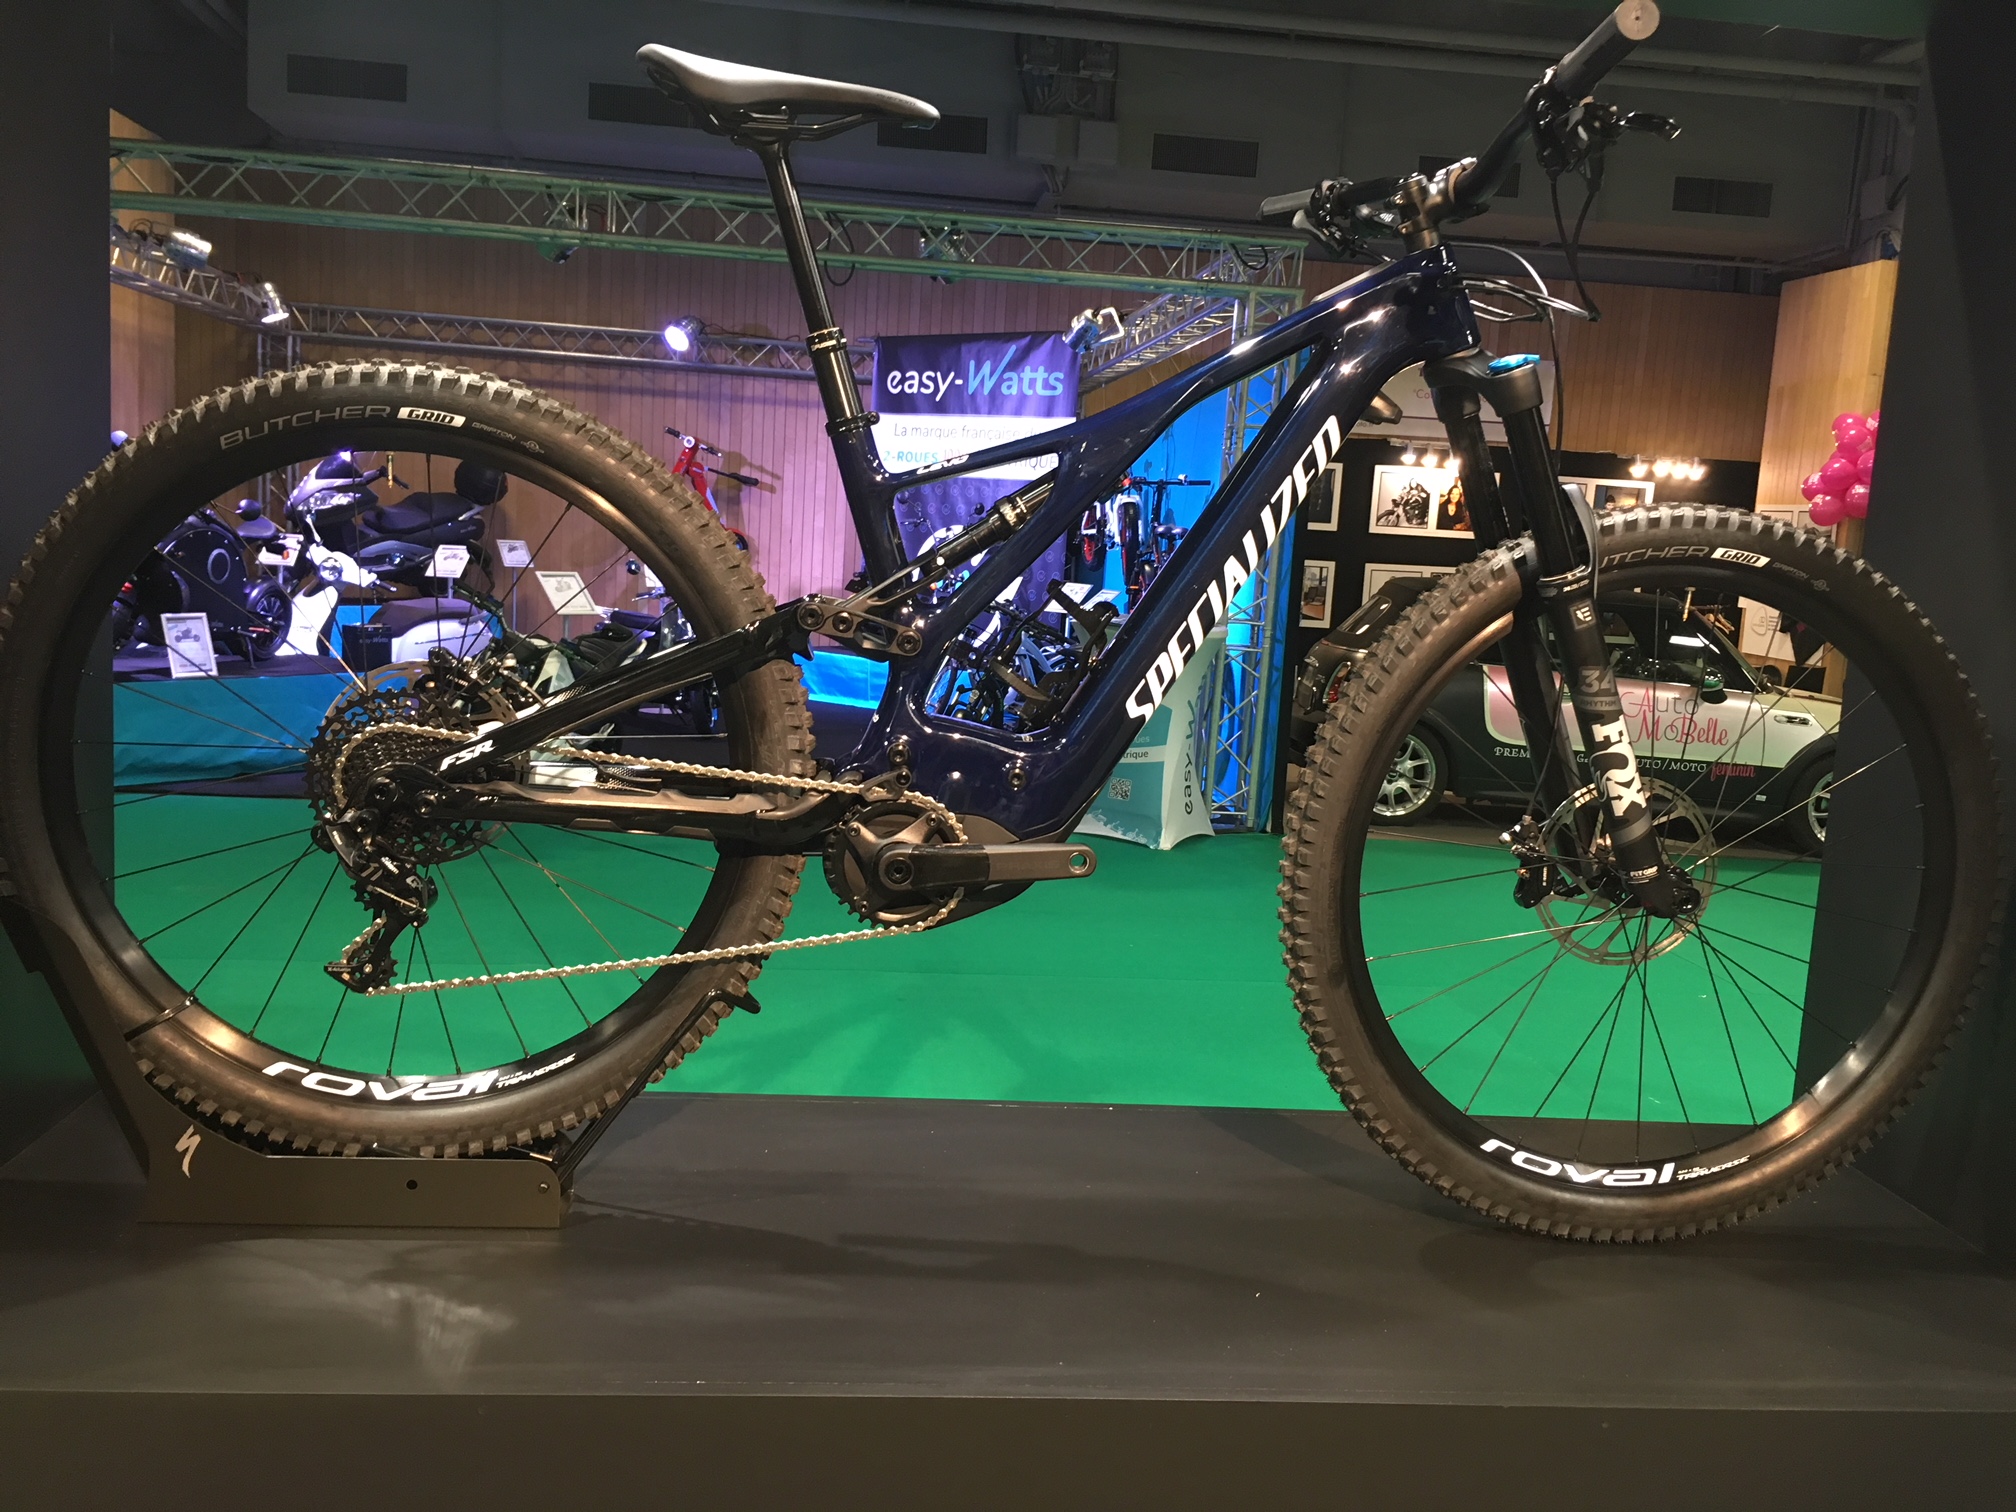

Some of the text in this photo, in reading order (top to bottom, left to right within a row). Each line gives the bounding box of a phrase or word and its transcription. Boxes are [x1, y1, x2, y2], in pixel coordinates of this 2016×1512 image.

[887, 344, 1065, 402] easy-Watts
[219, 405, 391, 450] BUTCHER
[407, 409, 456, 425] GRID
[894, 423, 908, 437] La
[911, 427, 958, 441] marque
[883, 450, 939, 464] 2-ROUES
[1125, 414, 1341, 724] SPECIALIZED
[1598, 546, 1710, 569] TCHER
[1719, 549, 1762, 566] GRID
[1581, 668, 1616, 693] 34
[1620, 687, 1700, 718] Auto
[440, 739, 497, 771] FSR
[1121, 750, 1149, 761] trique
[1494, 746, 1531, 758] PREM
[1637, 758, 1708, 773] UTO/MOTO
[1589, 714, 1647, 817] FOX
[261, 1061, 500, 1101] roval
[1479, 1138, 1676, 1187] roval
